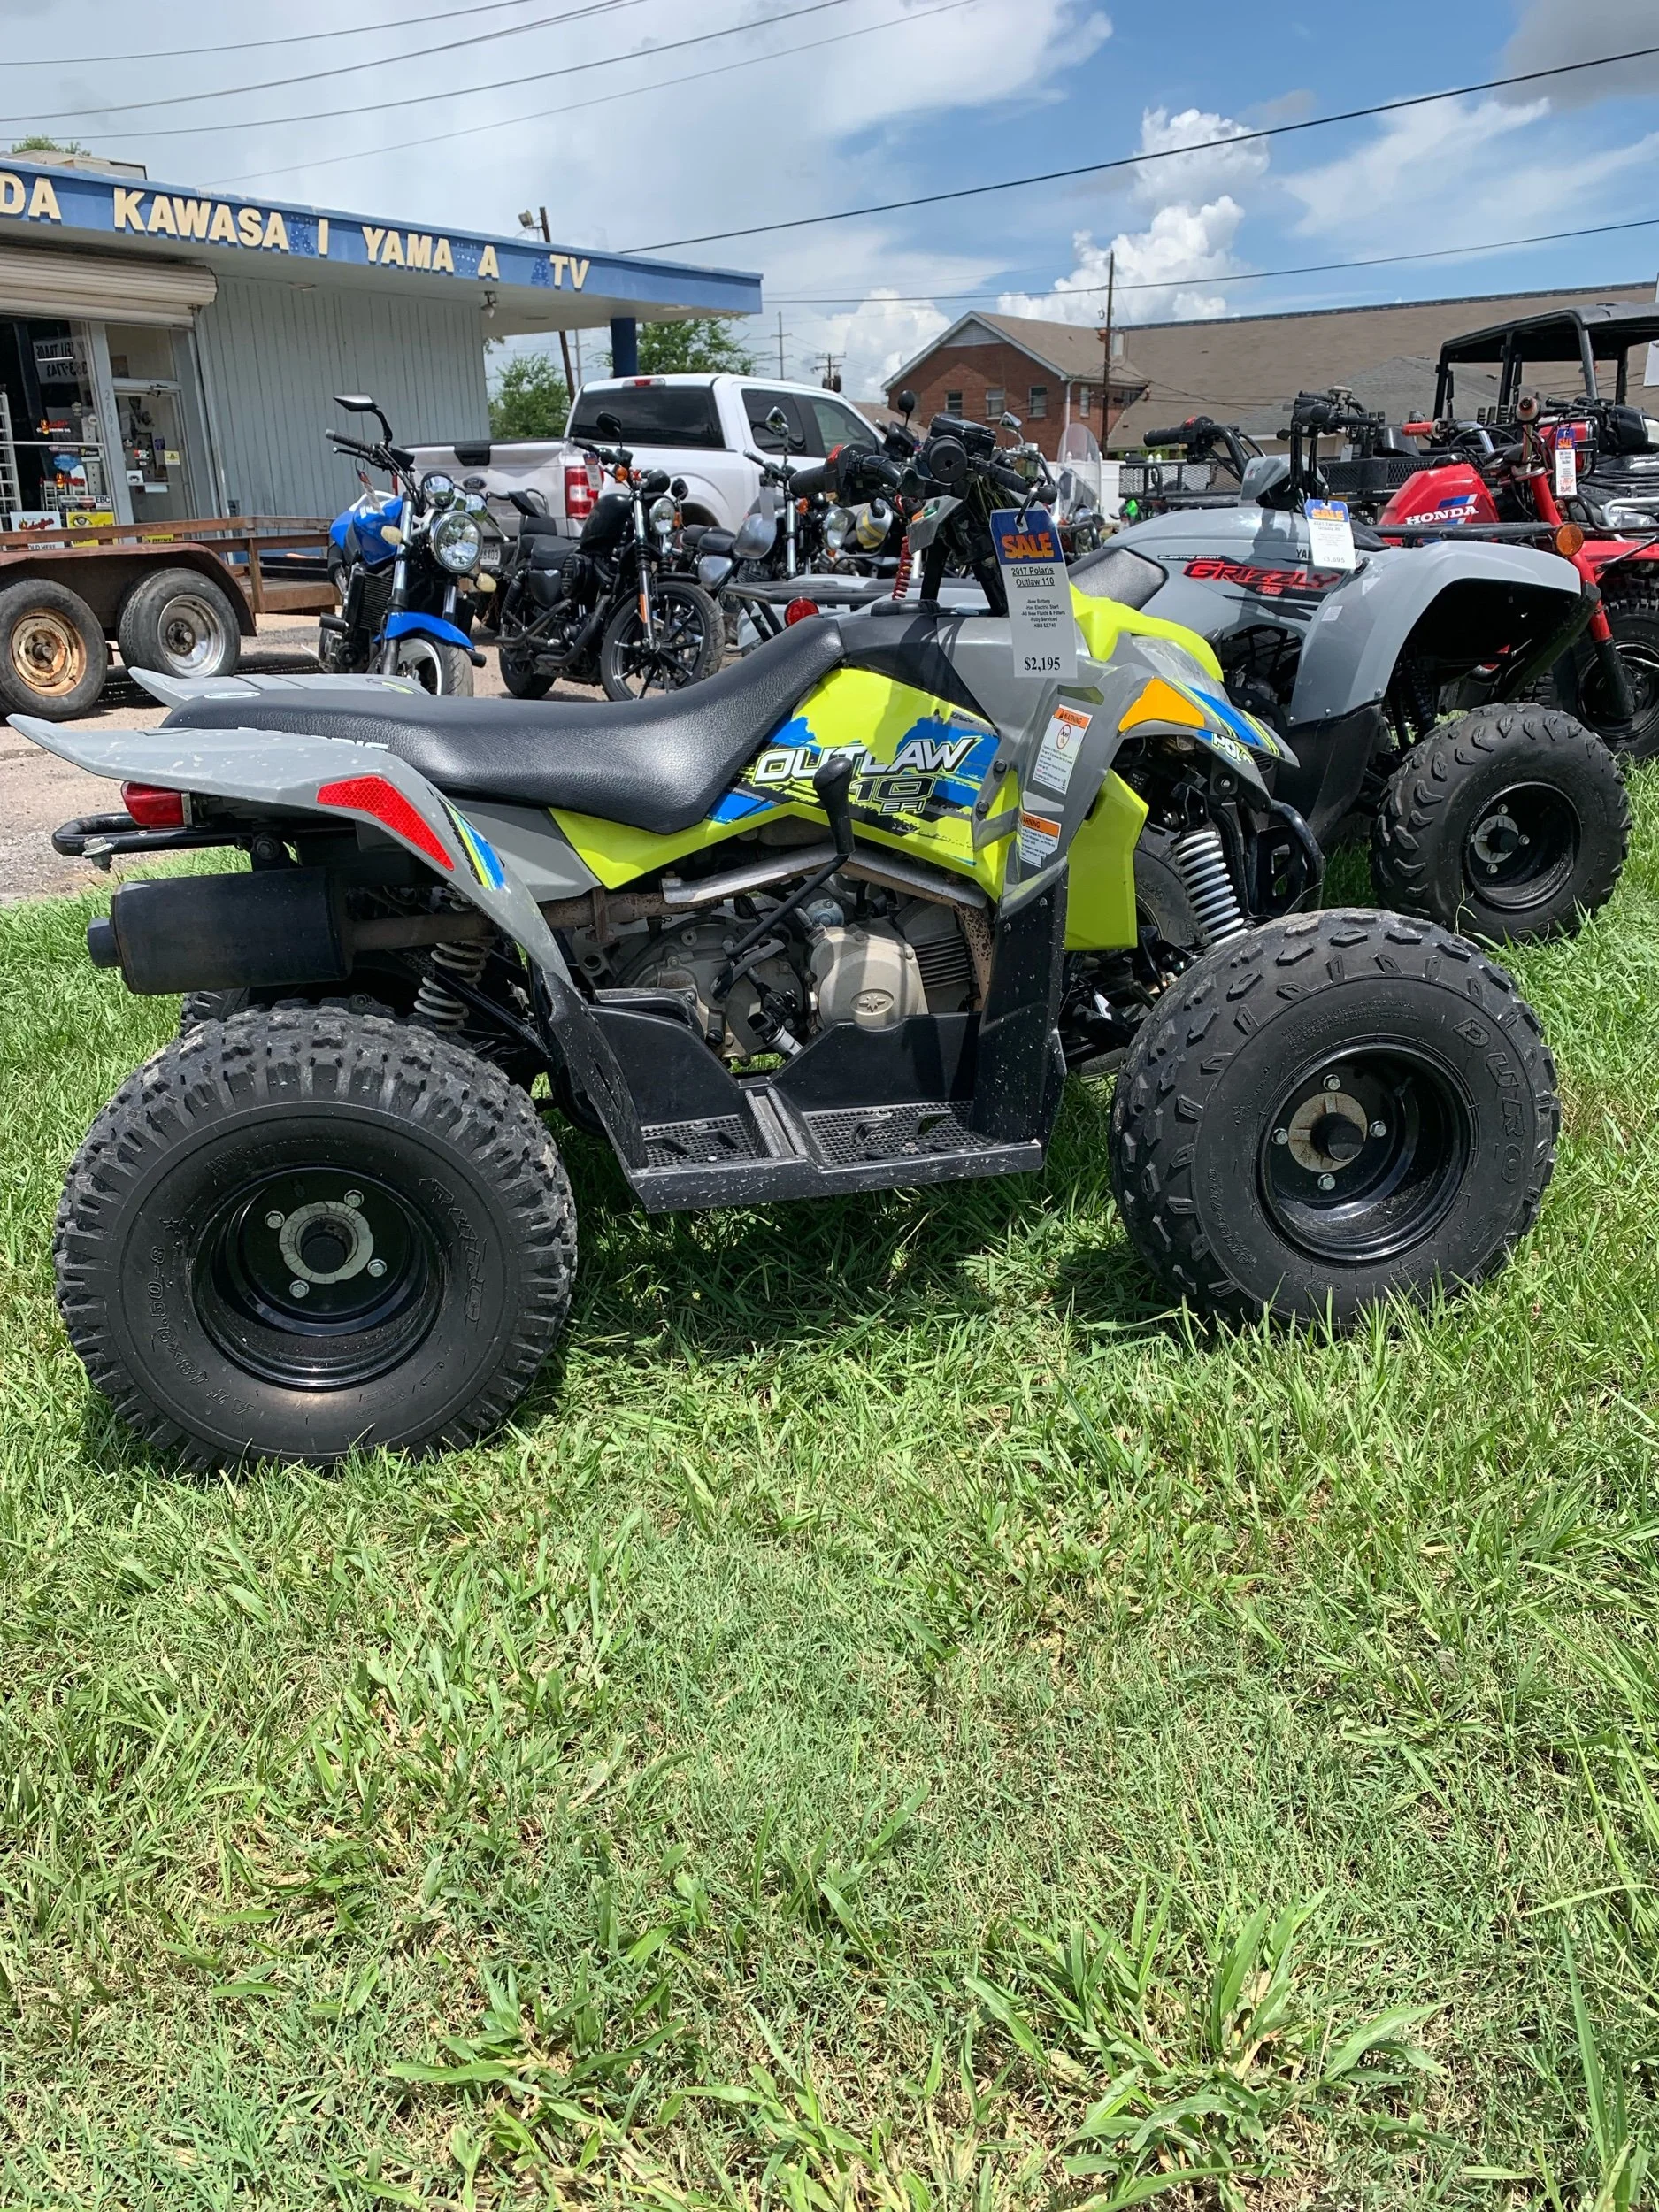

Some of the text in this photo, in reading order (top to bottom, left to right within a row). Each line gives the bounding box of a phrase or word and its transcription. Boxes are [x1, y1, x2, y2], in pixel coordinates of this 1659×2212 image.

[113, 187, 328, 255] KAWASAI
[362, 226, 500, 279] YAMAA
[531, 254, 590, 290] TV
[1557, 437, 1573, 449] SALE
[1311, 508, 1345, 520] SALE
[1405, 505, 1479, 525] HONDA
[1002, 533, 1055, 559] SALE
[1011, 566, 1055, 576] 2017 Polaris
[1183, 560, 1343, 588] GRIZZLY
[1016, 577, 1055, 587] Outlaw 110
[1024, 657, 1061, 672] $2,195
[1064, 712, 1083, 725] WARNING
[753, 738, 980, 784] OUTLAW
[836, 776, 937, 803] 10
[881, 801, 924, 813] EFI
[1022, 816, 1041, 829] ARNING
[1452, 1018, 1525, 1184] DURO
